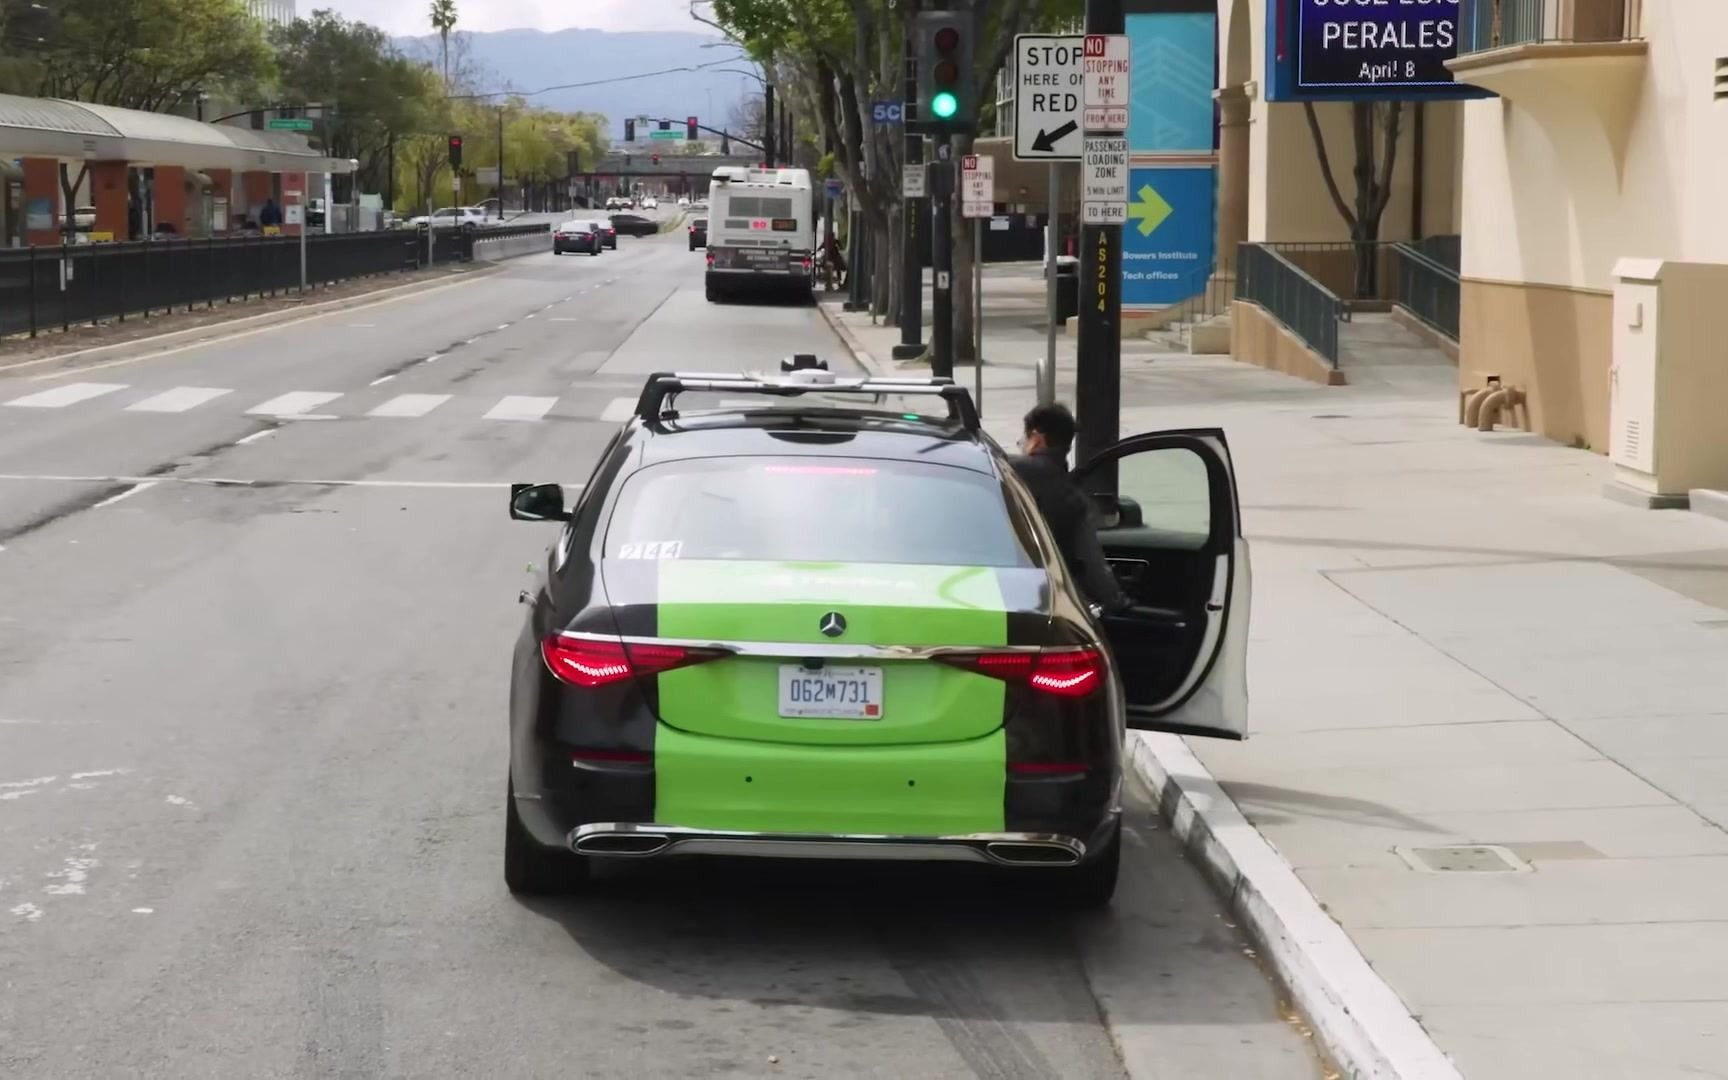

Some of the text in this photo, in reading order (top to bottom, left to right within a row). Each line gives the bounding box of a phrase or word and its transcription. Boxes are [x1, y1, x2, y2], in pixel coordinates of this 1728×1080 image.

[1322, 20, 1455, 49] PERALES
[1086, 38, 1103, 55] NO
[1027, 47, 1083, 66] STOP
[1086, 60, 1128, 73] STOPPING
[1023, 73, 1060, 86] HERE
[1098, 76, 1115, 85] ANY
[1098, 88, 1115, 98] TIME
[1032, 93, 1078, 112] RED
[1086, 113, 1126, 123] FROM HERE
[1085, 140, 1127, 152] PASSENGER
[964, 157, 976, 169] NO
[1087, 154, 1125, 165] LOADING
[1095, 167, 1117, 178] ZONE
[1093, 186, 1105, 195] MIN
[1106, 186, 1124, 195] LIMIT
[1088, 207, 1124, 217] TO HERE
[1122, 251, 1198, 260] Bowers Institute
[1122, 271, 1179, 280] Tech offices
[791, 679, 871, 704] 062M731
